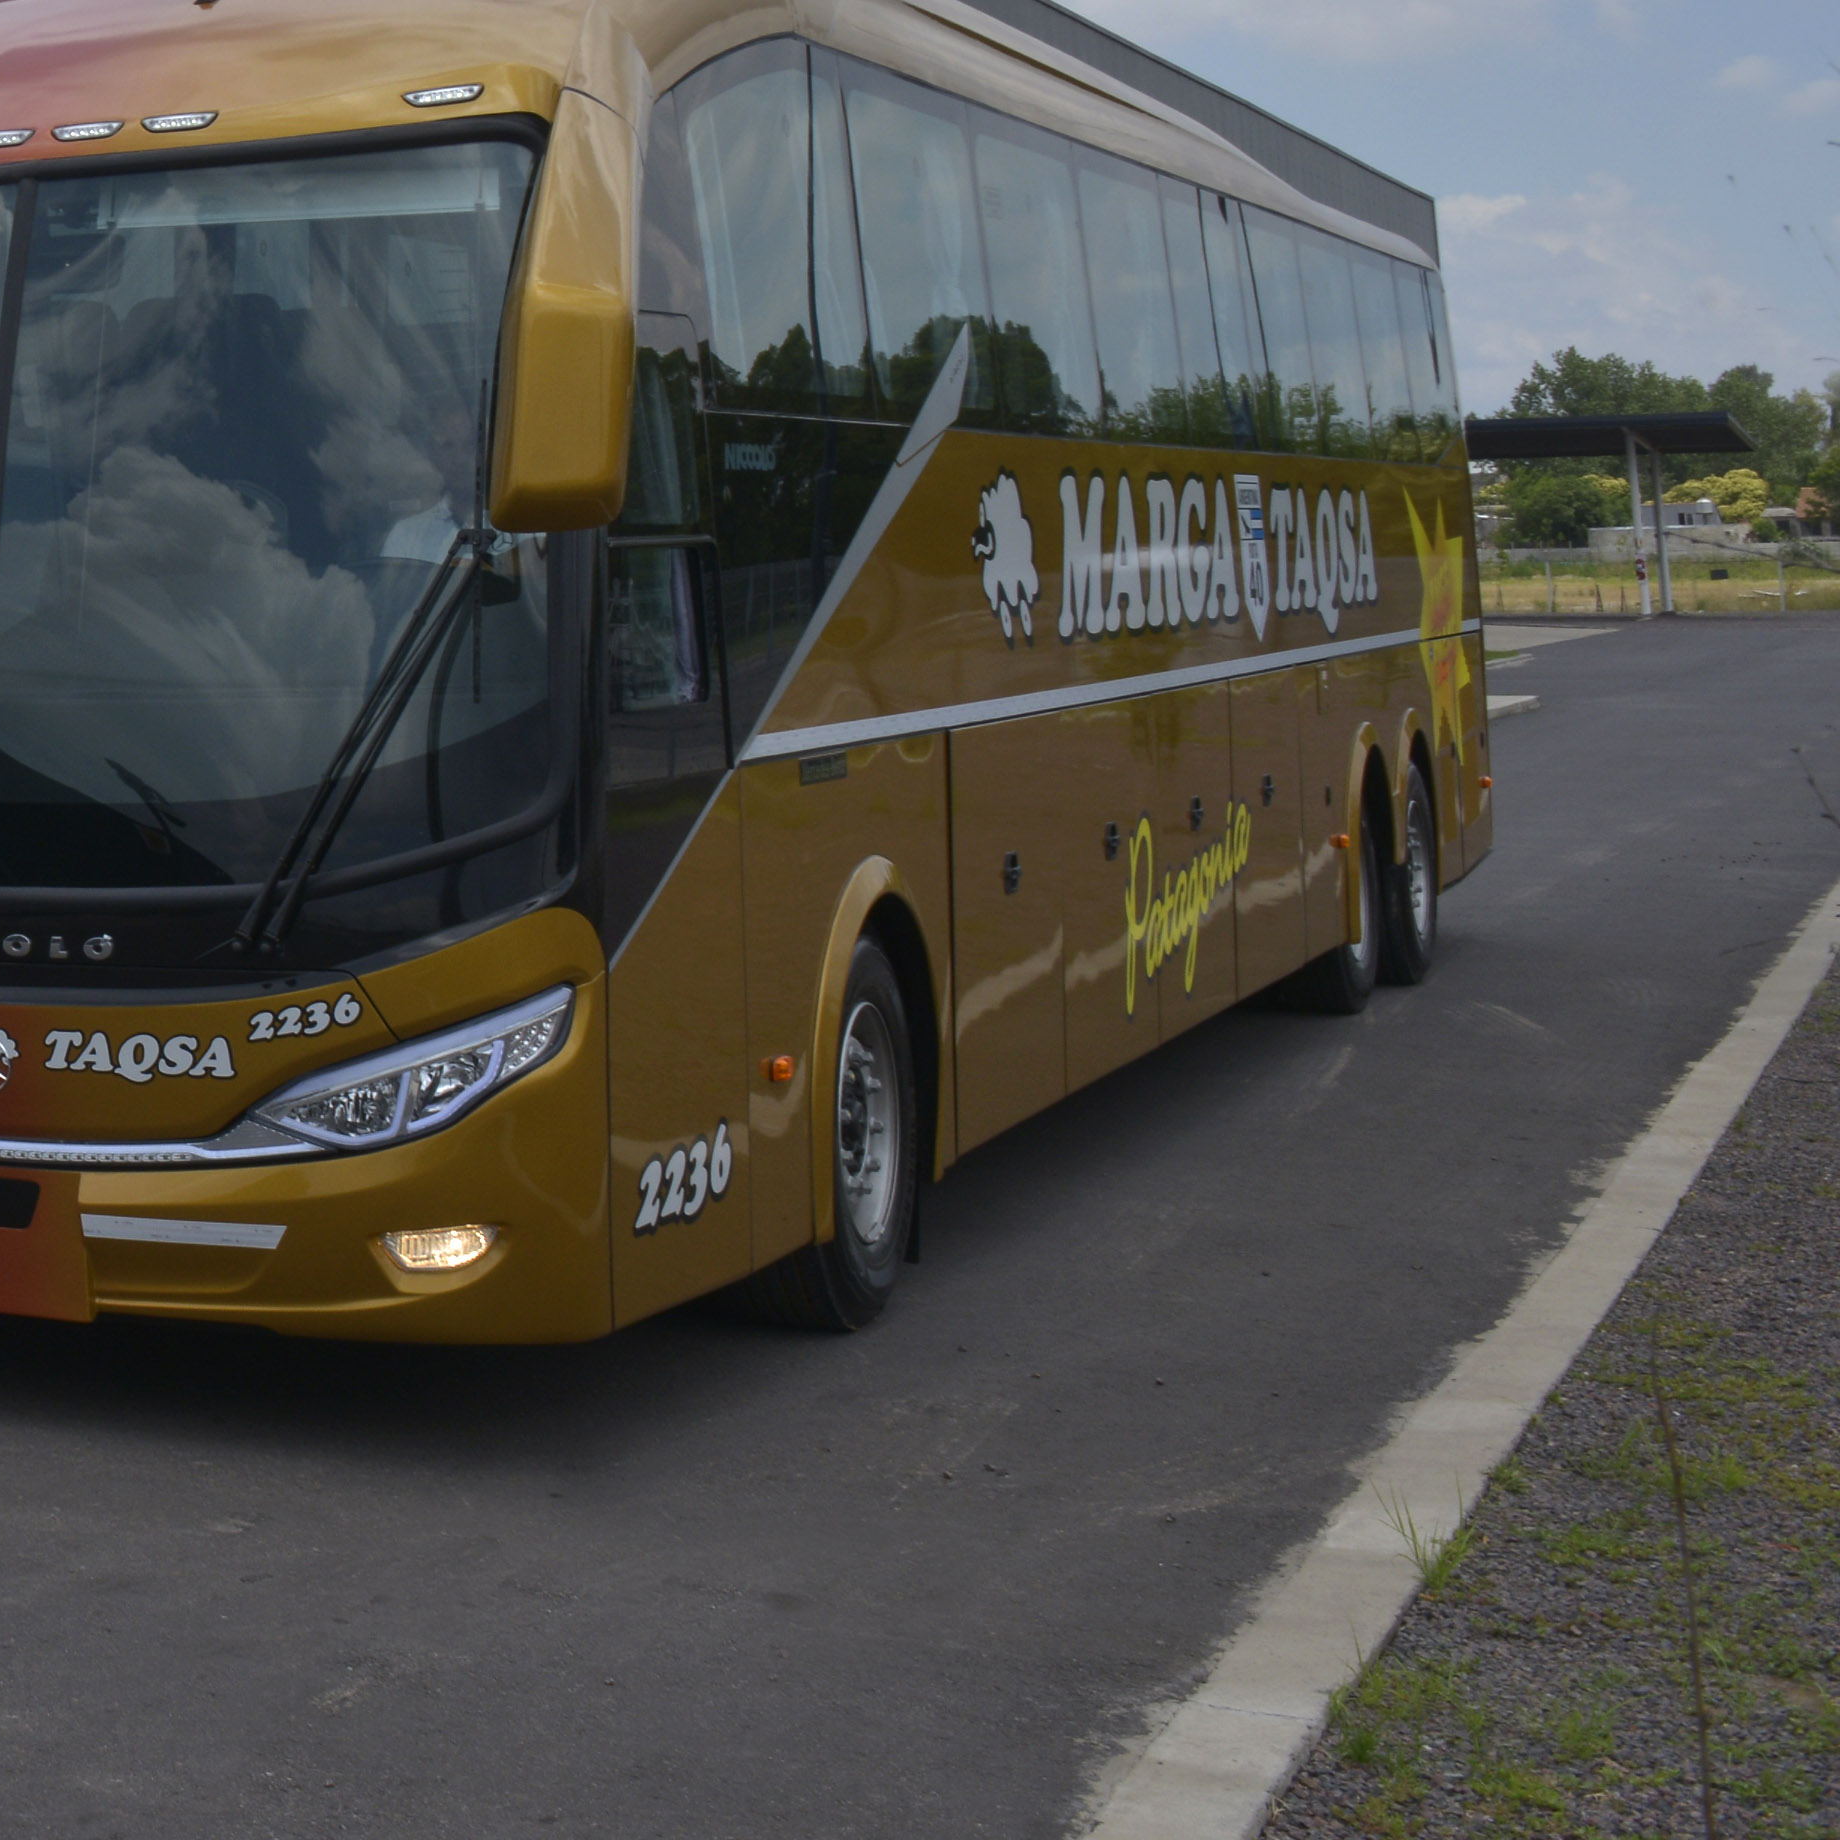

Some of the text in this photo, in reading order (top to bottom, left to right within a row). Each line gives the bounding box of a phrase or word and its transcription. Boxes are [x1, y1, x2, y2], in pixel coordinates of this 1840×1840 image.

[1058, 472, 1240, 640] MARGA
[1270, 485, 1378, 636] TAQSA
[1125, 800, 1252, 1016] Patagonia
[44, 1029, 236, 1083] TAQSA
[248, 993, 362, 1042] 2236
[634, 1121, 732, 1232] 2236
